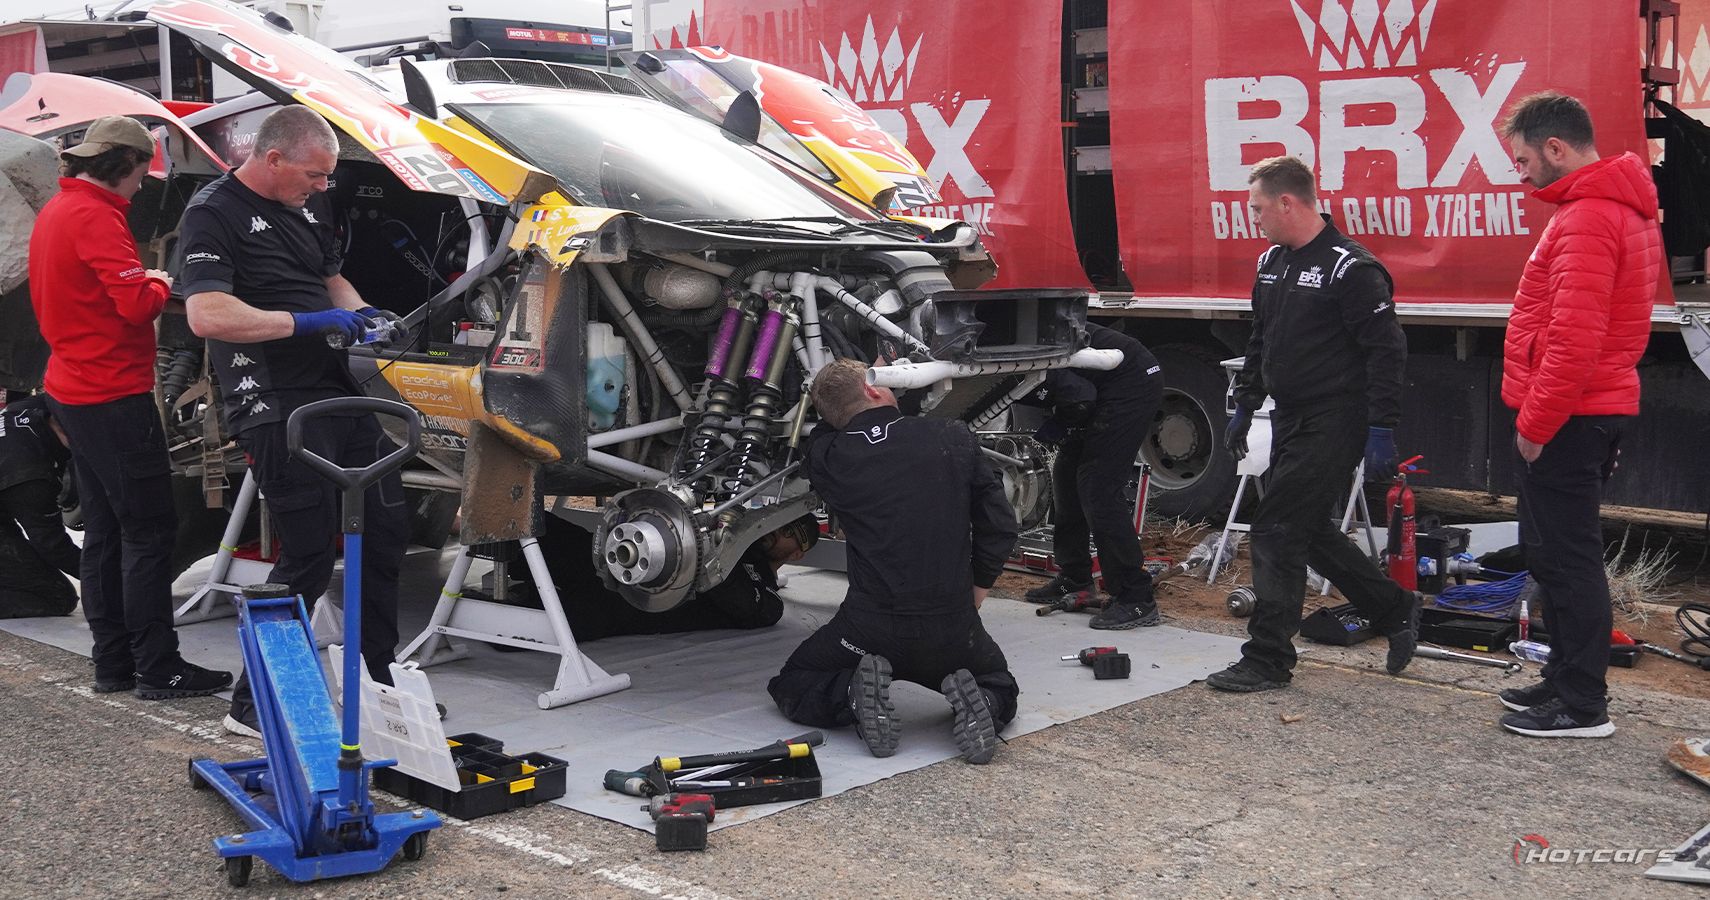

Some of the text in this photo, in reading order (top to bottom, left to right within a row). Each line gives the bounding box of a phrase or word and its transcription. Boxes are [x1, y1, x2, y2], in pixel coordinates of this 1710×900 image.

[509, 30, 533, 38] MOTUL
[1205, 61, 1527, 194] BRX
[403, 154, 469, 195] 20
[1342, 196, 1411, 238] RAID
[1424, 192, 1530, 238] XTREME
[840, 637, 866, 656] sparco
